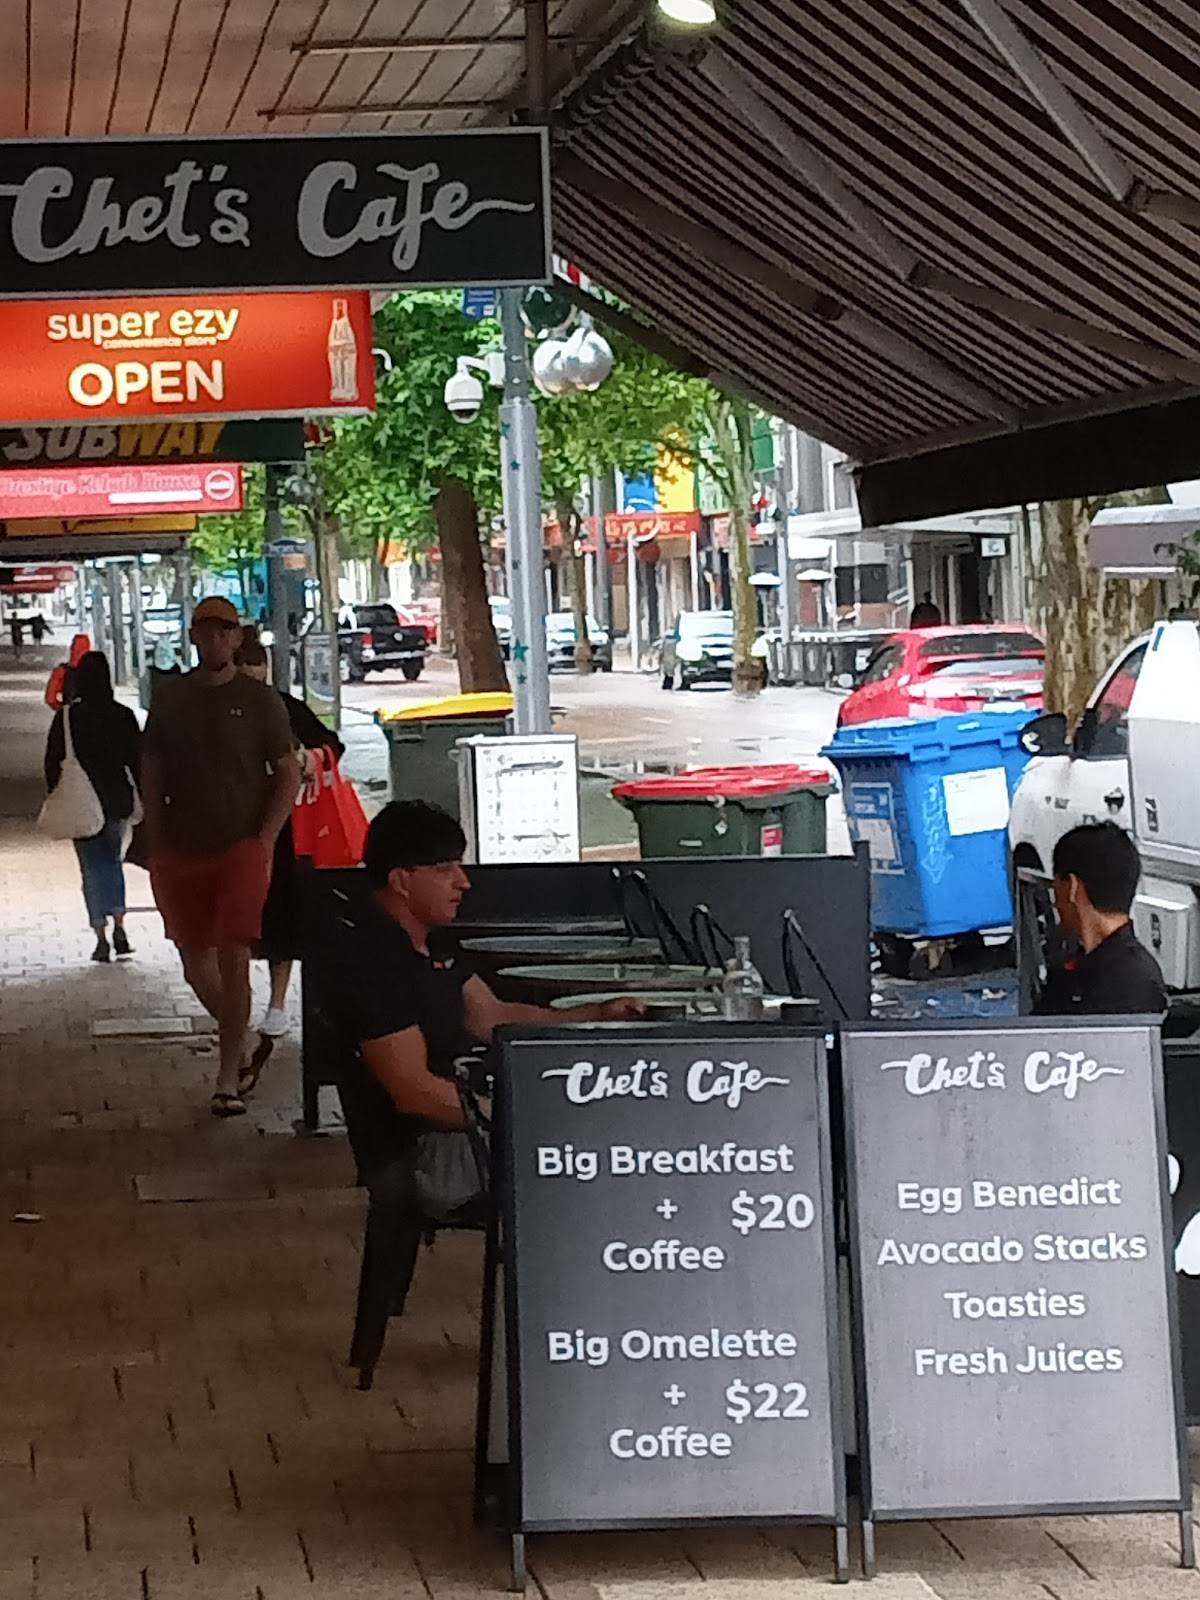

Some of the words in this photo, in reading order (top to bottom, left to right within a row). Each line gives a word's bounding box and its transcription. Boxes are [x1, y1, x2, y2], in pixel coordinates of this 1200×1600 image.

[0, 160, 251, 263] Chet's
[298, 160, 535, 271] Cafe
[47, 310, 161, 345] super
[169, 308, 239, 341] ezy
[68, 359, 224, 406] OPEN
[2, 421, 226, 461] SUBWAY
[542, 1059, 669, 1104] Chet's
[687, 1060, 790, 1108] Cafe
[880, 1051, 1006, 1095] Chet's
[1024, 1051, 1125, 1099] Cafe
[537, 1144, 598, 1181] Big
[610, 1142, 794, 1176] Breakfast
[731, 1190, 815, 1235] $20
[897, 1183, 962, 1214] Egg
[972, 1177, 1121, 1208] Benedict
[602, 1239, 726, 1271] Coffee
[877, 1235, 1024, 1266] Avocado
[1033, 1232, 1148, 1262] Stacks
[944, 1288, 1086, 1319] Toasties
[548, 1329, 610, 1366] Big
[620, 1329, 797, 1360] Omelette
[915, 1347, 1008, 1376] Fresh
[1016, 1343, 1124, 1373] Juices
[725, 1378, 810, 1424] $22
[609, 1426, 733, 1458] Coffee
